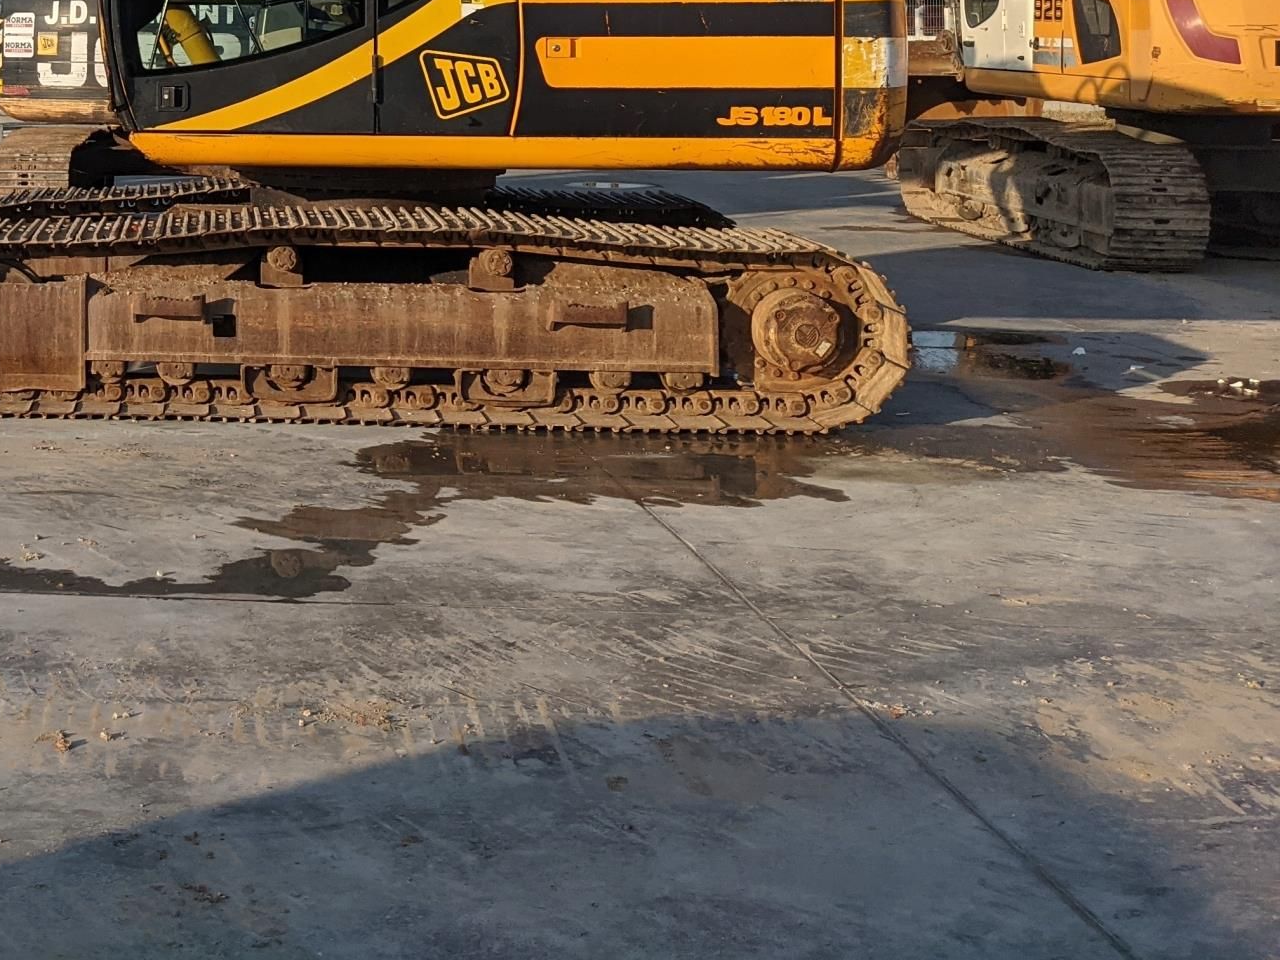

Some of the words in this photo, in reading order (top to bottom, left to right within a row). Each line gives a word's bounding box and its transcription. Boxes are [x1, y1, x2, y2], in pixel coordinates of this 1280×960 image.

[6, 16, 33, 24] NORMA
[44, 0, 97, 25] J.D.
[433, 58, 502, 111] JCB
